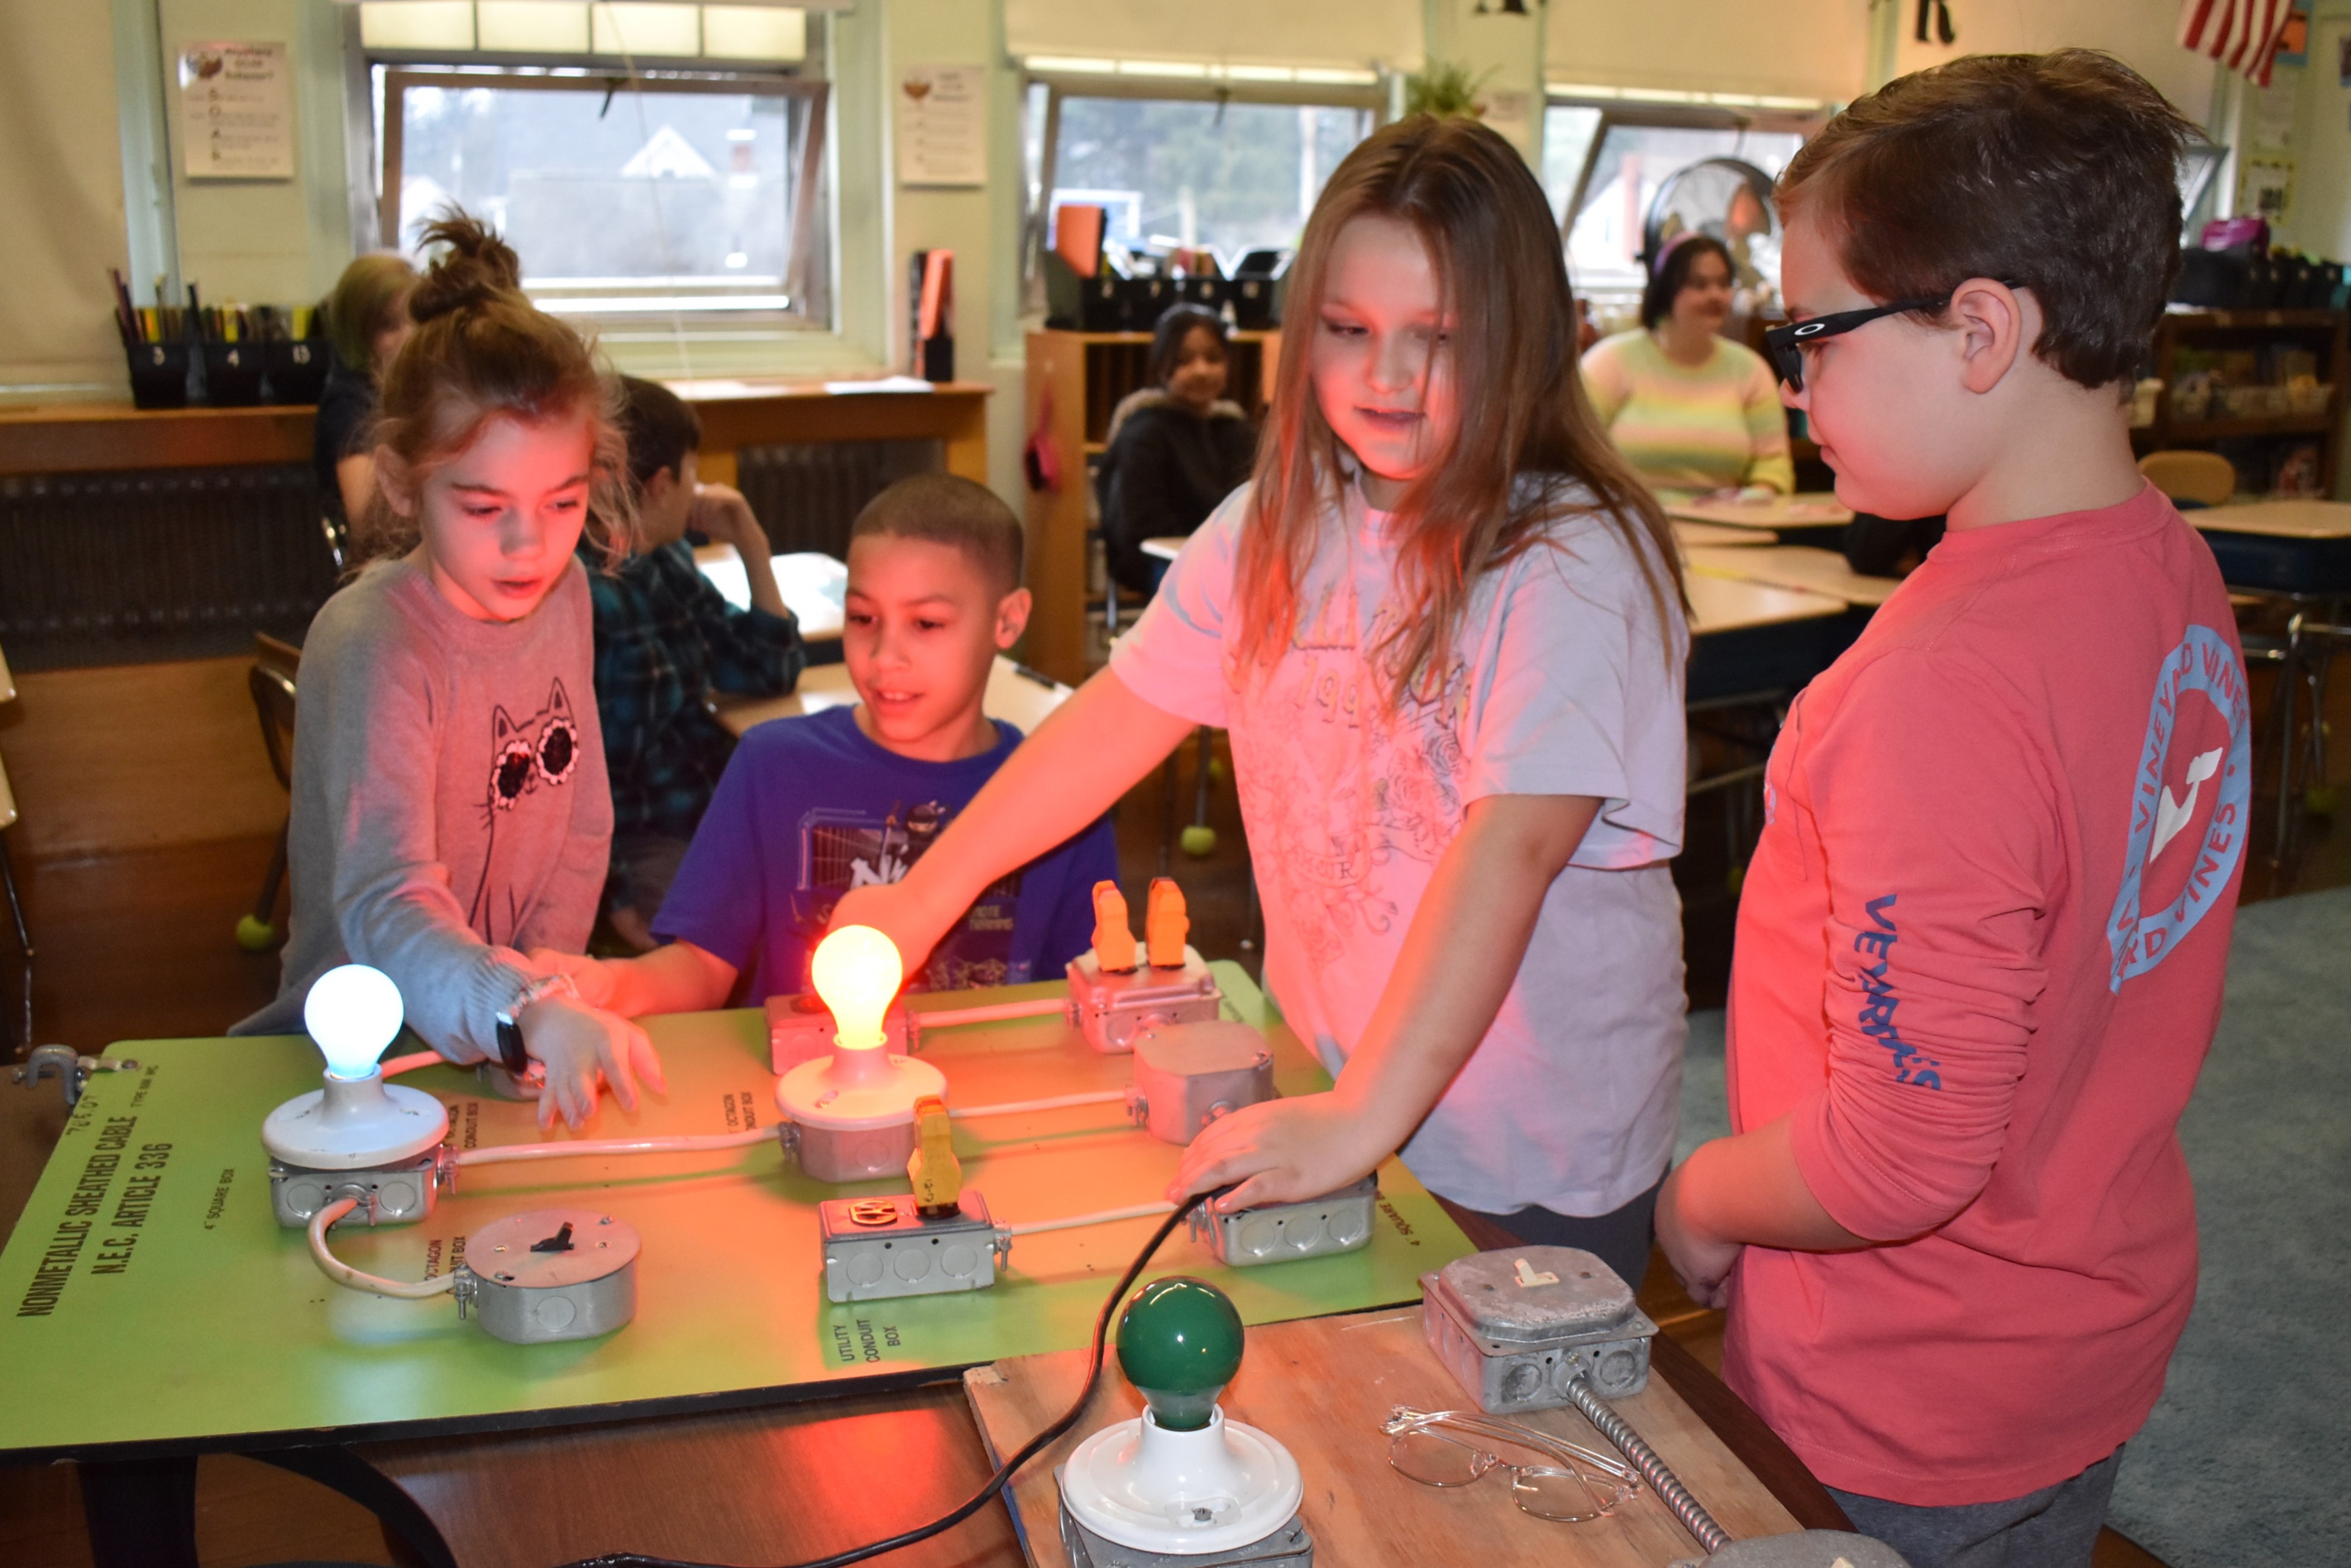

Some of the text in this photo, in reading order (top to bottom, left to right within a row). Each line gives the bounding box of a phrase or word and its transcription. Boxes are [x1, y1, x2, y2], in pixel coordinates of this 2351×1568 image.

[724, 1094, 738, 1127] OCTAGON
[135, 1142, 173, 1170] 336
[17, 1116, 138, 1317] NONMETALLIC SHEATHED CABLE
[111, 1175, 161, 1228] ARTICLE
[206, 1187, 229, 1219] SQUARE
[452, 1236, 466, 1256] BOX
[833, 1325, 854, 1362] UTILITY
[857, 1319, 880, 1363] CONDUIT
[883, 1326, 901, 1347] BOX
